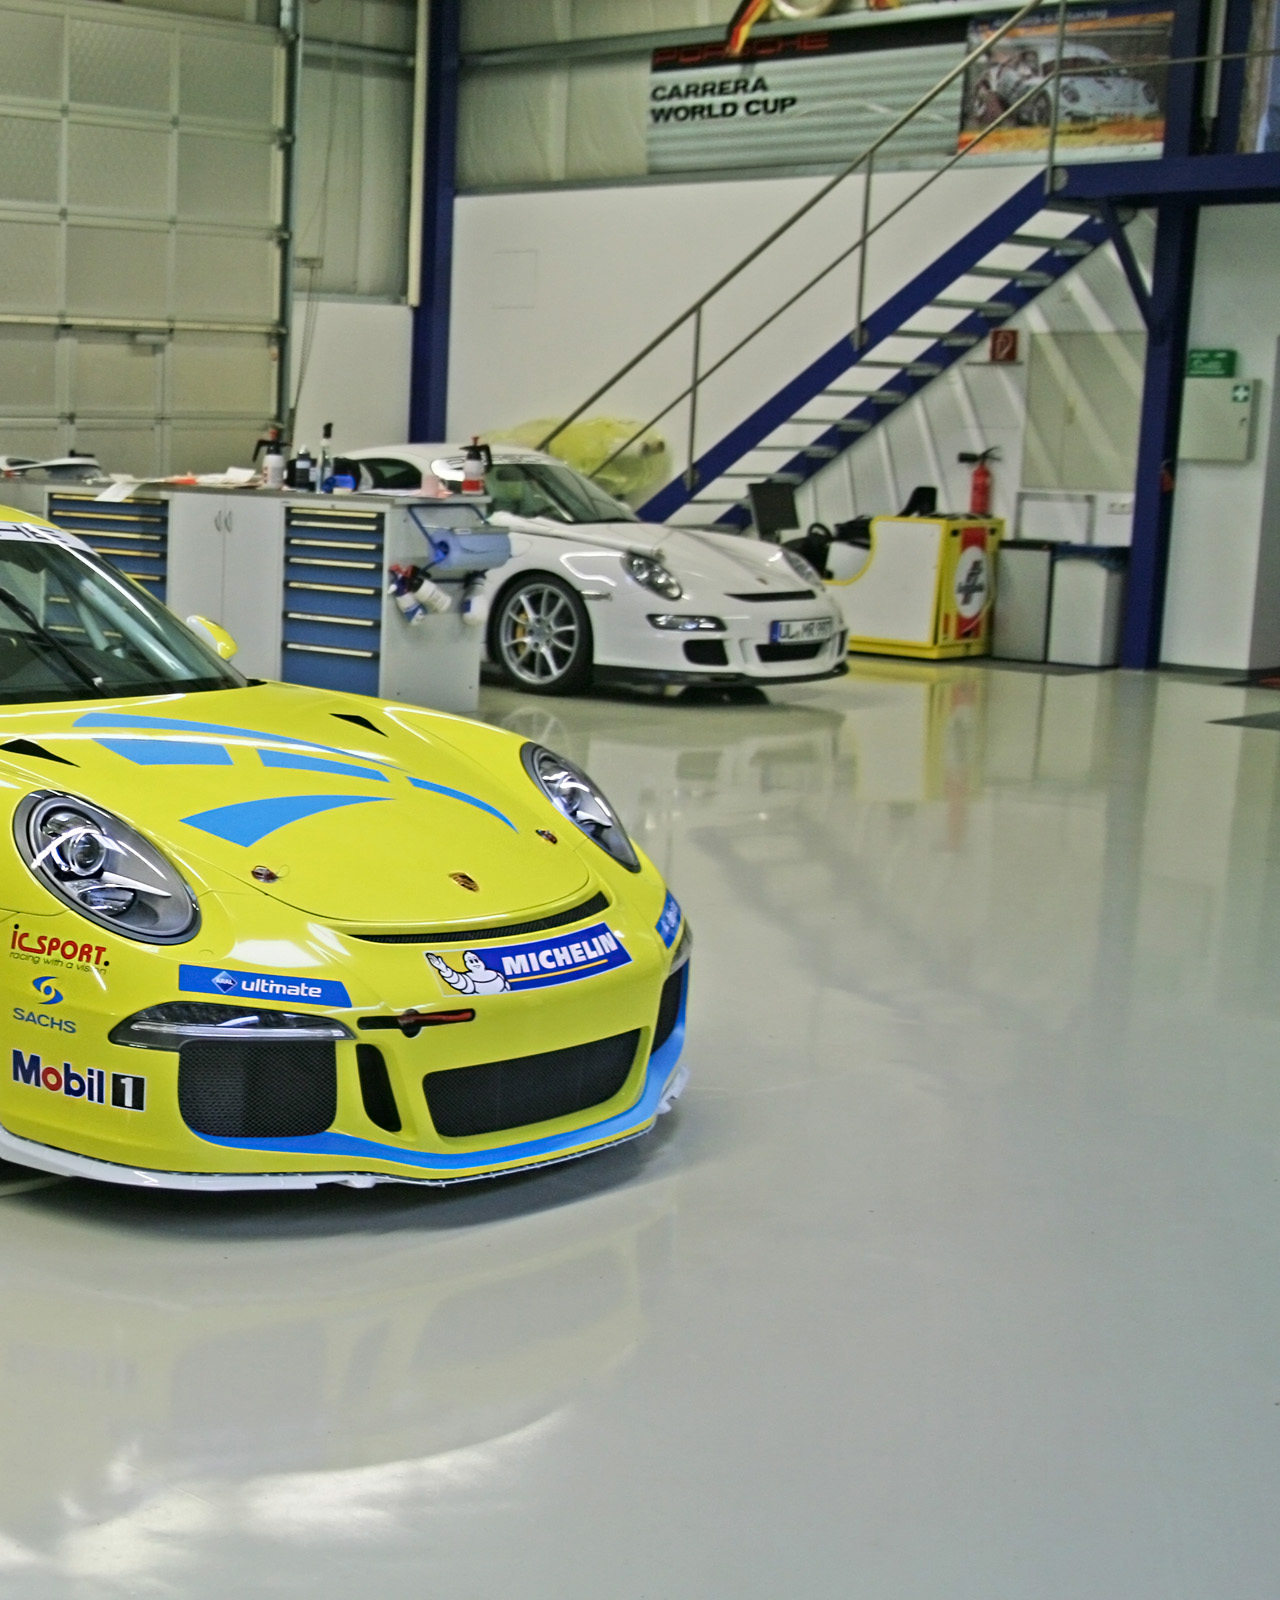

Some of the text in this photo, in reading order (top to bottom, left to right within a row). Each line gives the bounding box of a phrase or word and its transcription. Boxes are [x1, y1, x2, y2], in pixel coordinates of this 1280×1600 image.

[654, 32, 829, 64] PORCHE
[651, 77, 769, 102] CARRERA
[651, 97, 797, 124] WORLD CUP
[9, 951, 41, 964] racing
[43, 957, 63, 967] with
[65, 961, 73, 969] a
[501, 932, 619, 976] MICHELIN
[241, 978, 322, 998] ultimate
[13, 1008, 76, 1034] SACHS
[12, 1048, 105, 1105] Mobil
